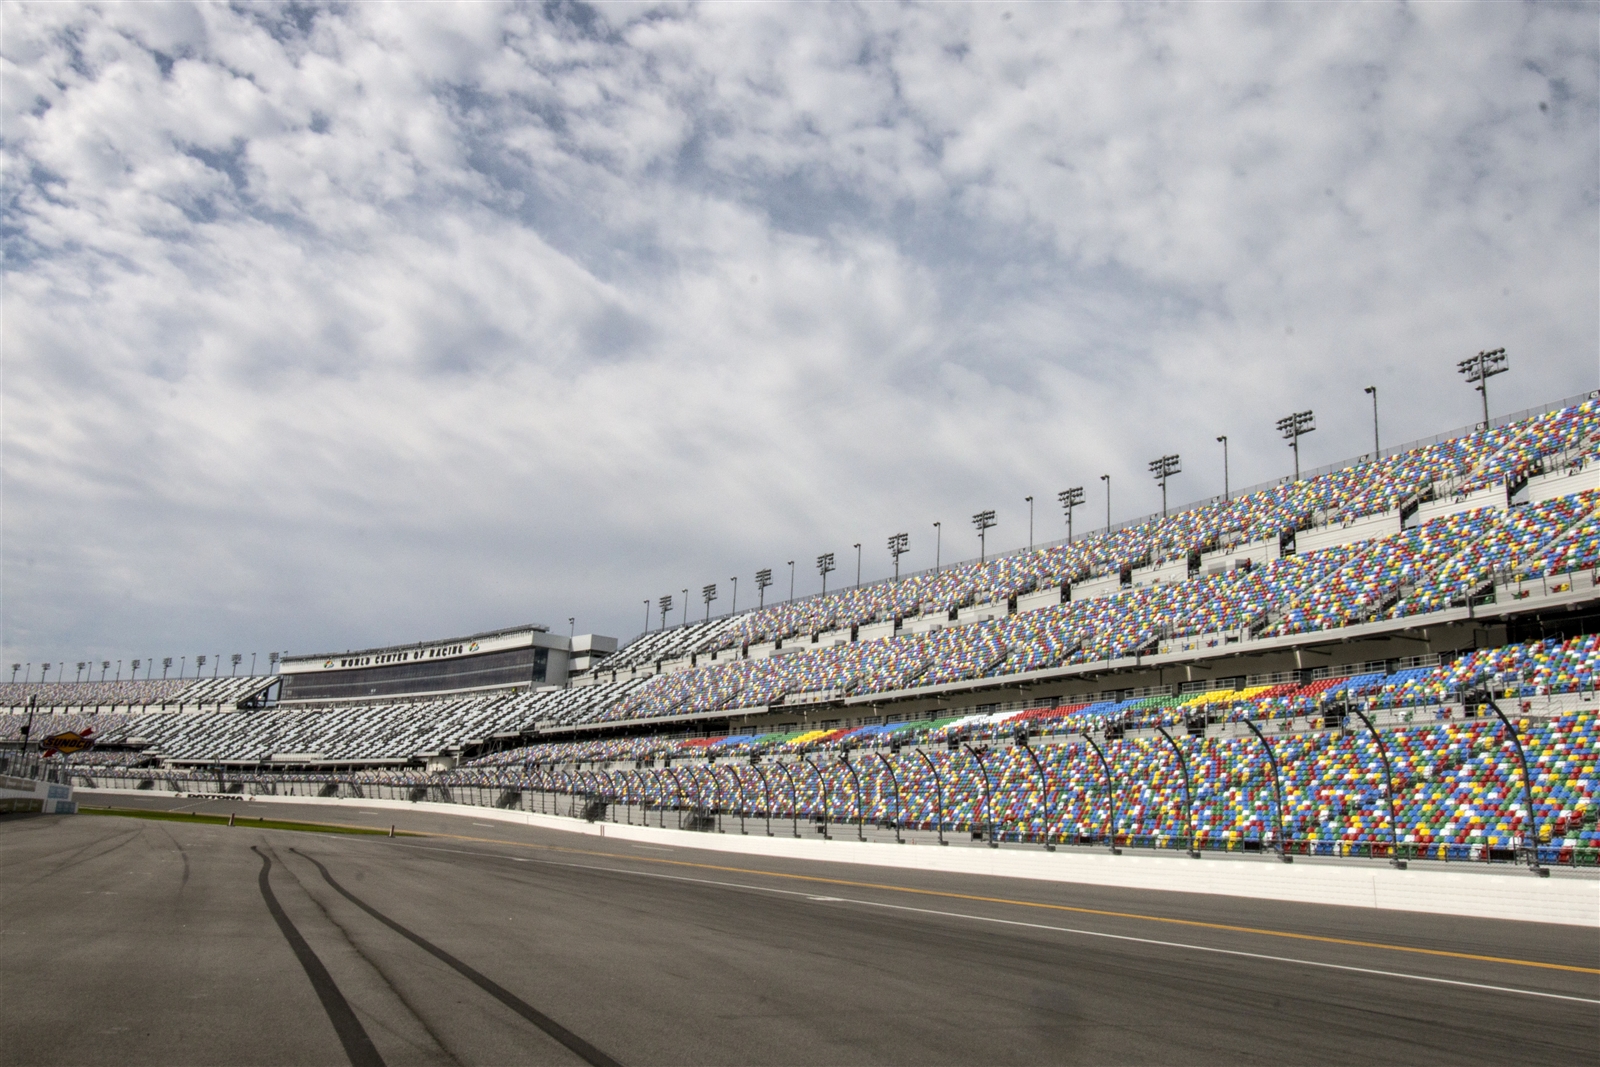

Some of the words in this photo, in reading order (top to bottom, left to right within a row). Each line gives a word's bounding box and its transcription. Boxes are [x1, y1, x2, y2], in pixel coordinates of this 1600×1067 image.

[341, 657, 370, 667] WORLD
[375, 652, 408, 664] CENTER
[414, 650, 425, 660] OF
[429, 645, 463, 657] RACING
[45, 737, 93, 749] SUNOCO
[187, 793, 244, 801] DAYTONA
